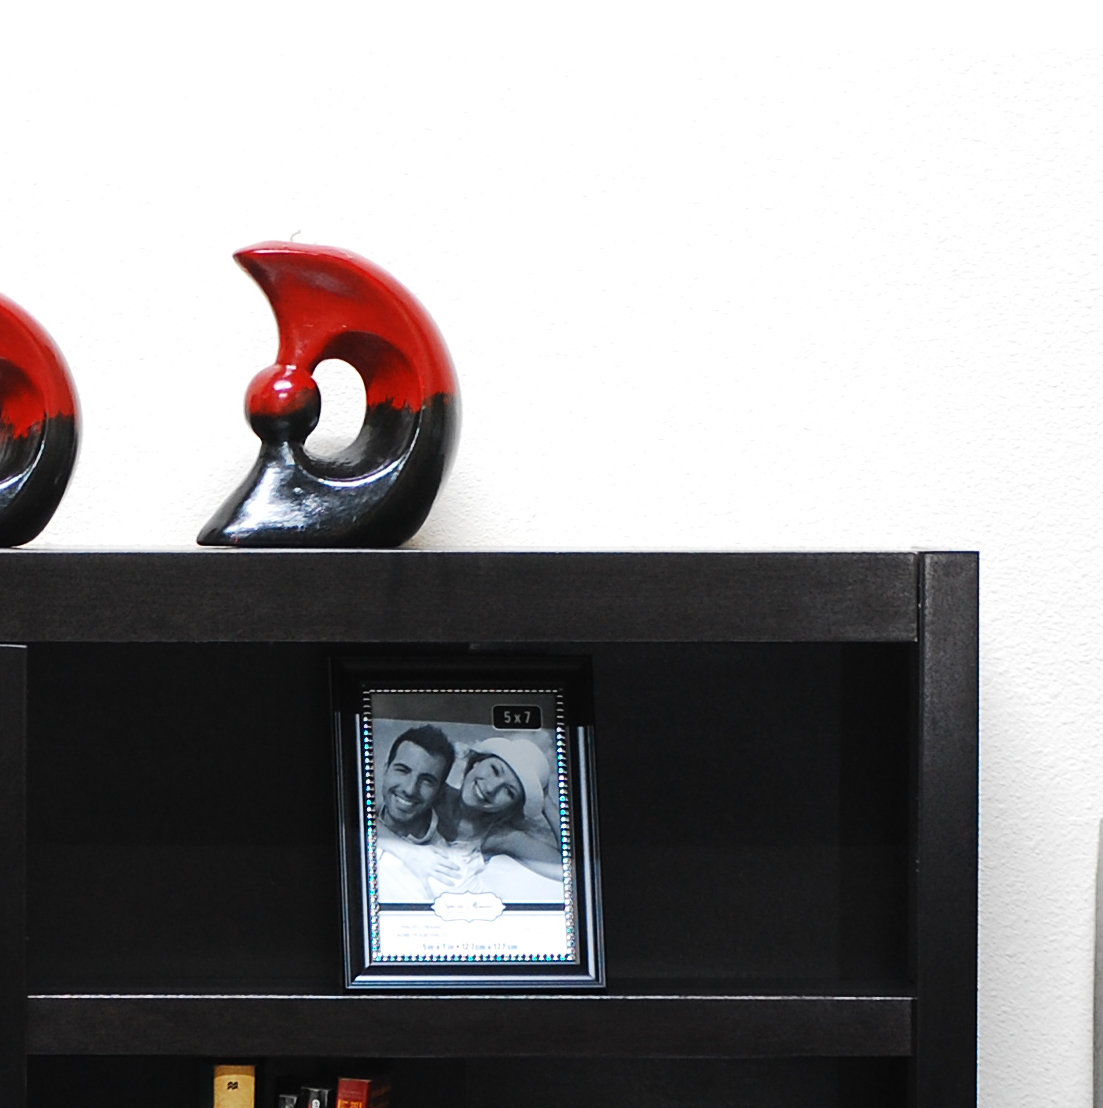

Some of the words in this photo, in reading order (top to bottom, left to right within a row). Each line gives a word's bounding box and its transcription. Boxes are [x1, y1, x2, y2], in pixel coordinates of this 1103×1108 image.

[504, 711, 511, 723] 5
[514, 714, 522, 723] x
[524, 711, 532, 724] 7
